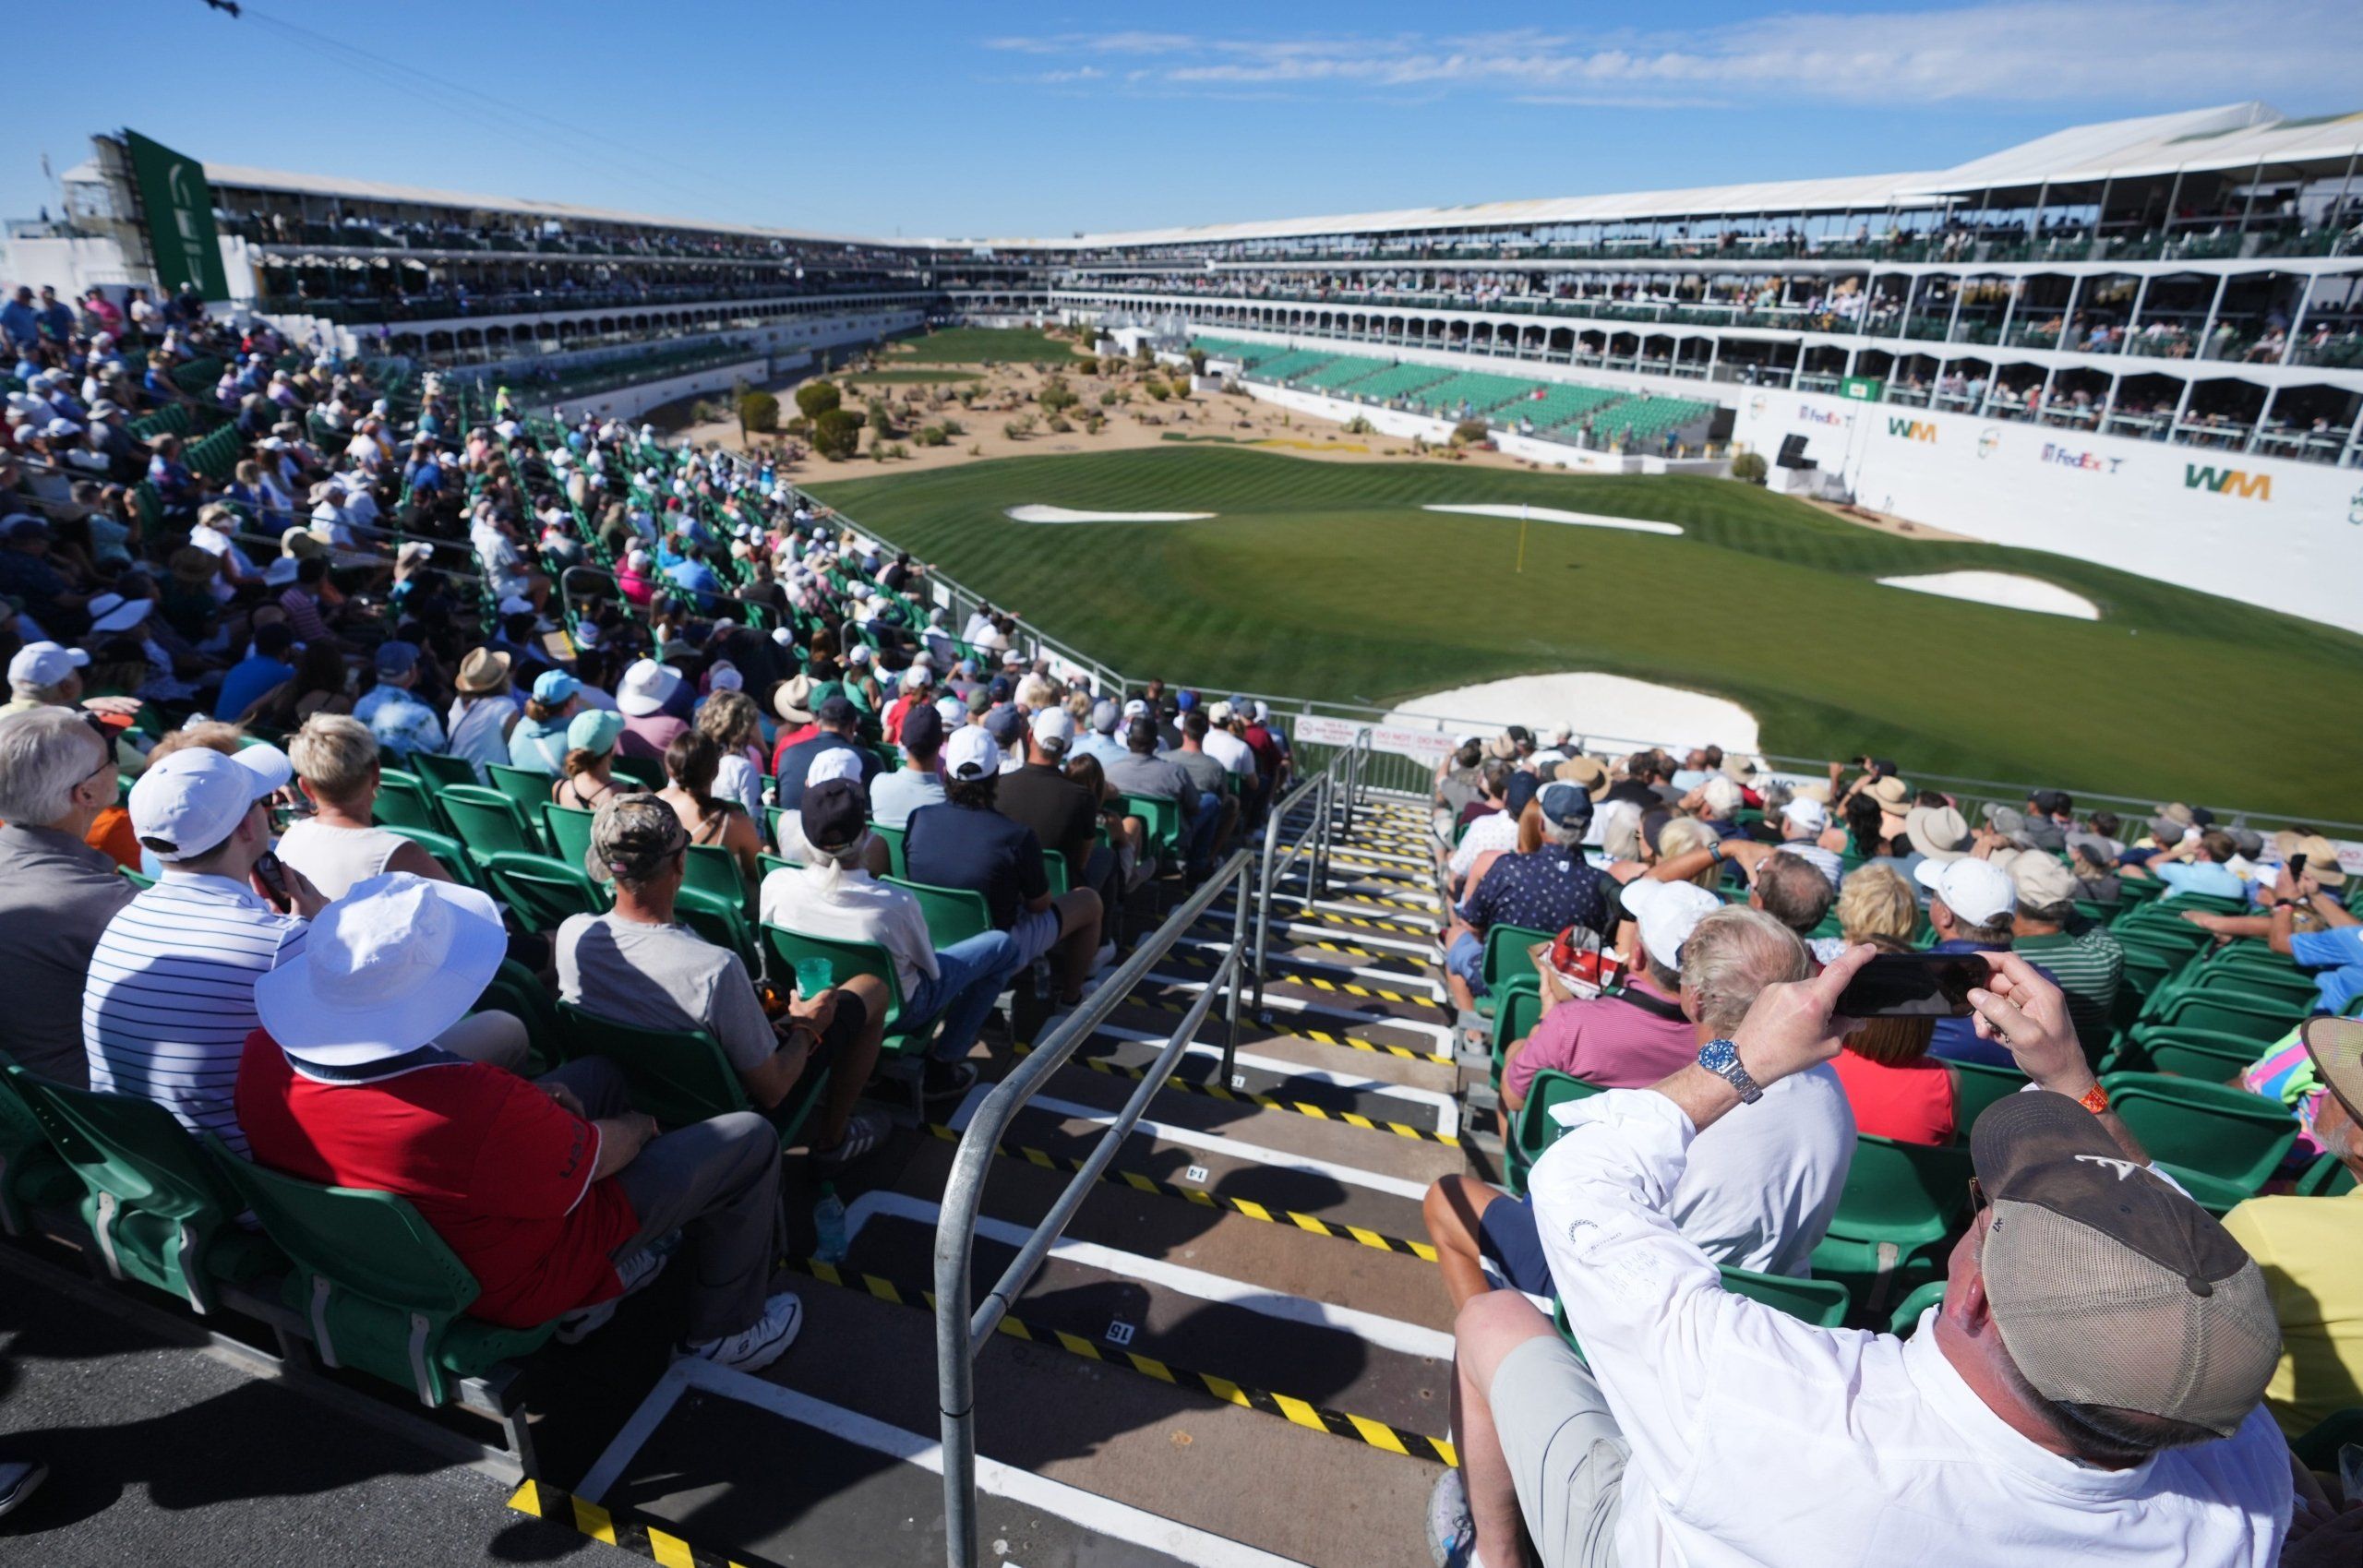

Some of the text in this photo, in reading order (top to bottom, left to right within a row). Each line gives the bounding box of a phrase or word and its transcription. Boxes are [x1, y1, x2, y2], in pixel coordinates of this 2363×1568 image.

[1889, 417, 1937, 443] WM
[2056, 449, 2102, 471] FedEx
[2185, 463, 2271, 501] WM
[1108, 1323, 1129, 1341] 15
